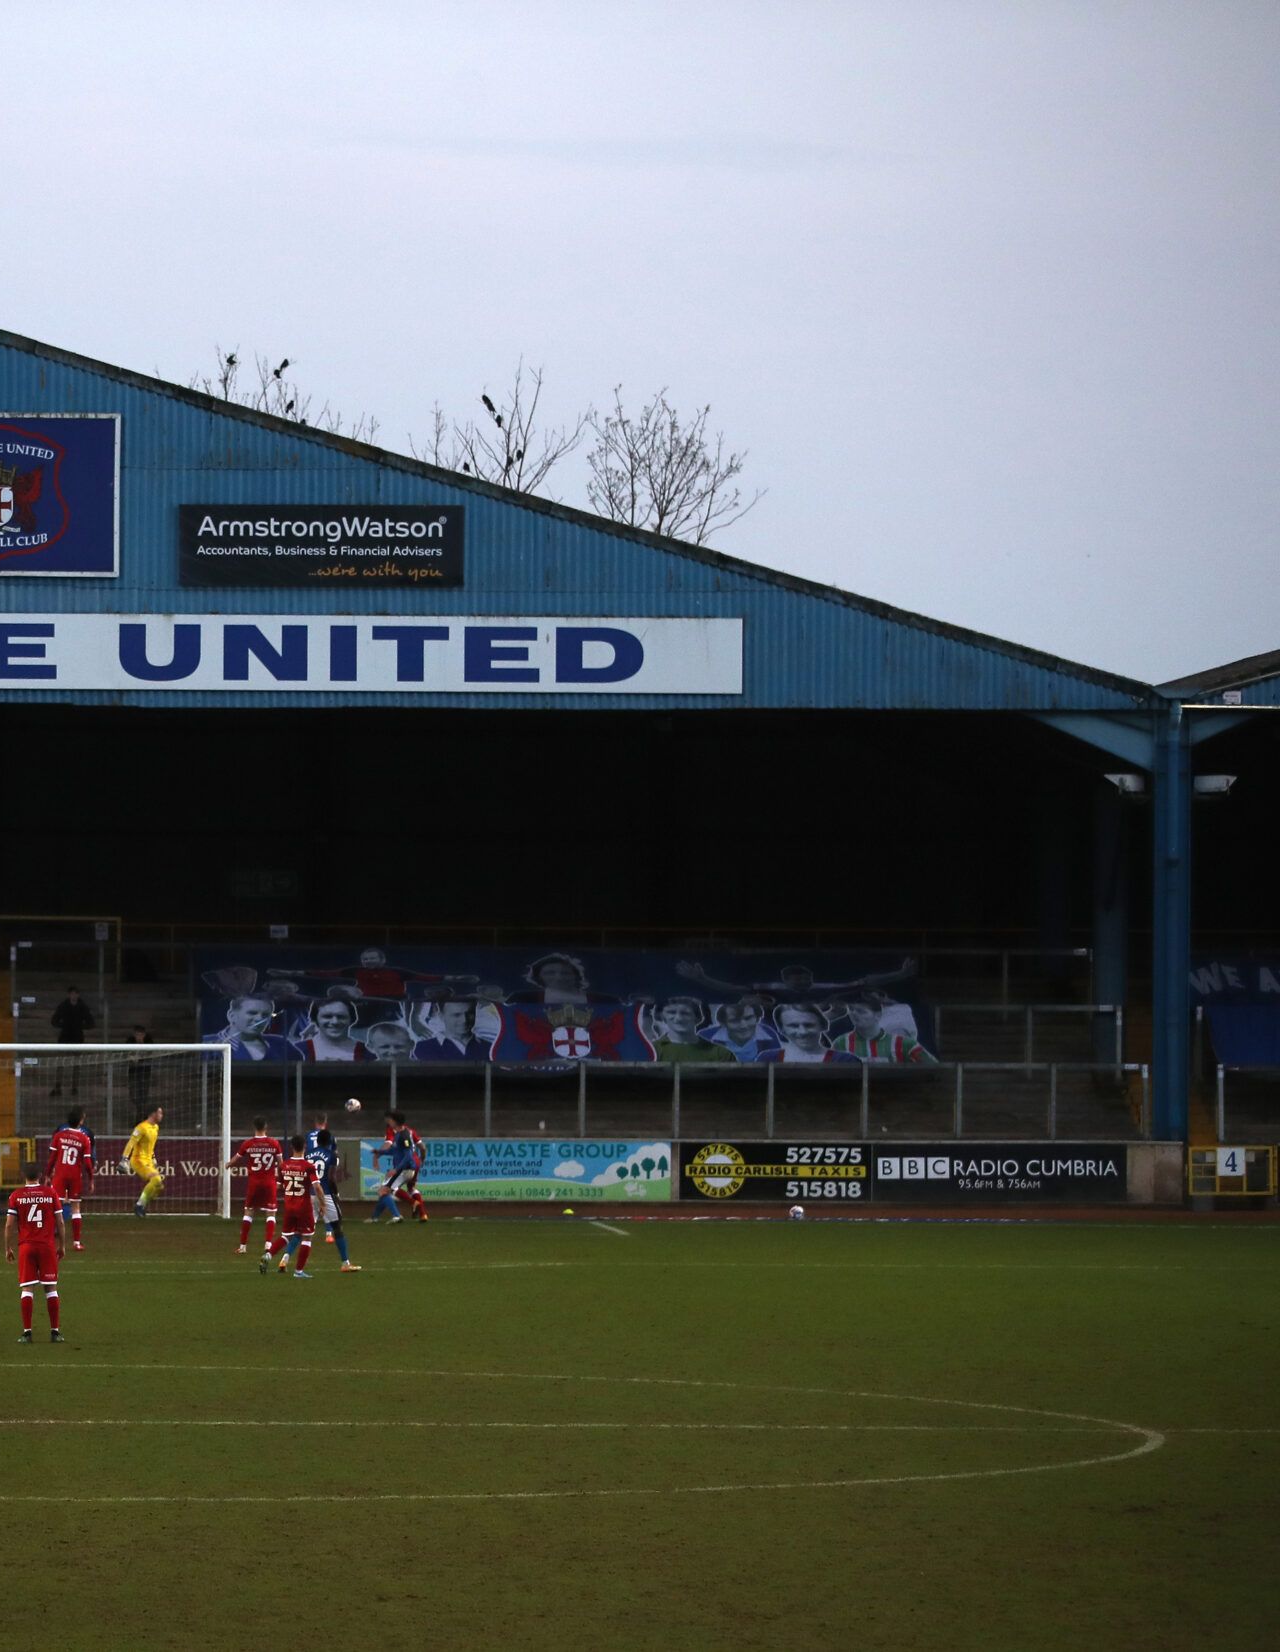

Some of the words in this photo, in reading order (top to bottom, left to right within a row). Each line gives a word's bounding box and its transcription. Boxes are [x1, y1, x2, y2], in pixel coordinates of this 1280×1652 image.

[6, 444, 55, 461] UNITED
[16, 532, 49, 548] CLUB
[196, 545, 272, 557] Accountants,
[275, 545, 326, 556] Business
[329, 546, 338, 556] &
[341, 545, 390, 556] Financial
[392, 546, 443, 557] Advisers
[362, 562, 403, 577] with
[408, 564, 444, 581] you
[119, 622, 645, 684] UNITED
[61, 1145, 78, 1165] 10
[417, 1142, 477, 1158] BRIA
[484, 1143, 551, 1158] WASTE
[558, 1143, 628, 1159] GROUP
[697, 1143, 740, 1161] 527575
[785, 1147, 862, 1164] 527575
[179, 1160, 248, 1177] Woolen
[250, 1153, 274, 1171] 39
[440, 1158, 481, 1169] provider
[483, 1158, 493, 1167] of
[495, 1159, 524, 1168] waste
[525, 1159, 543, 1167] and
[688, 1166, 731, 1176] RADIO
[734, 1166, 799, 1176] CARLISLE
[808, 1165, 862, 1176] TAXIS
[880, 1158, 948, 1177] BBC
[953, 1159, 1019, 1177] RADIO
[1026, 1159, 1118, 1177] CUMBRIA
[1224, 1151, 1237, 1173] 4
[501, 1167, 540, 1176] Cumbria
[283, 1175, 305, 1196] 25
[556, 1187, 574, 1196] 241
[697, 1180, 740, 1197] 515818
[785, 1181, 862, 1198] 515818
[958, 1179, 993, 1190] 95.6FM
[996, 1179, 1005, 1189] &
[1007, 1179, 1041, 1190] 756AM
[27, 1204, 43, 1228] 4
